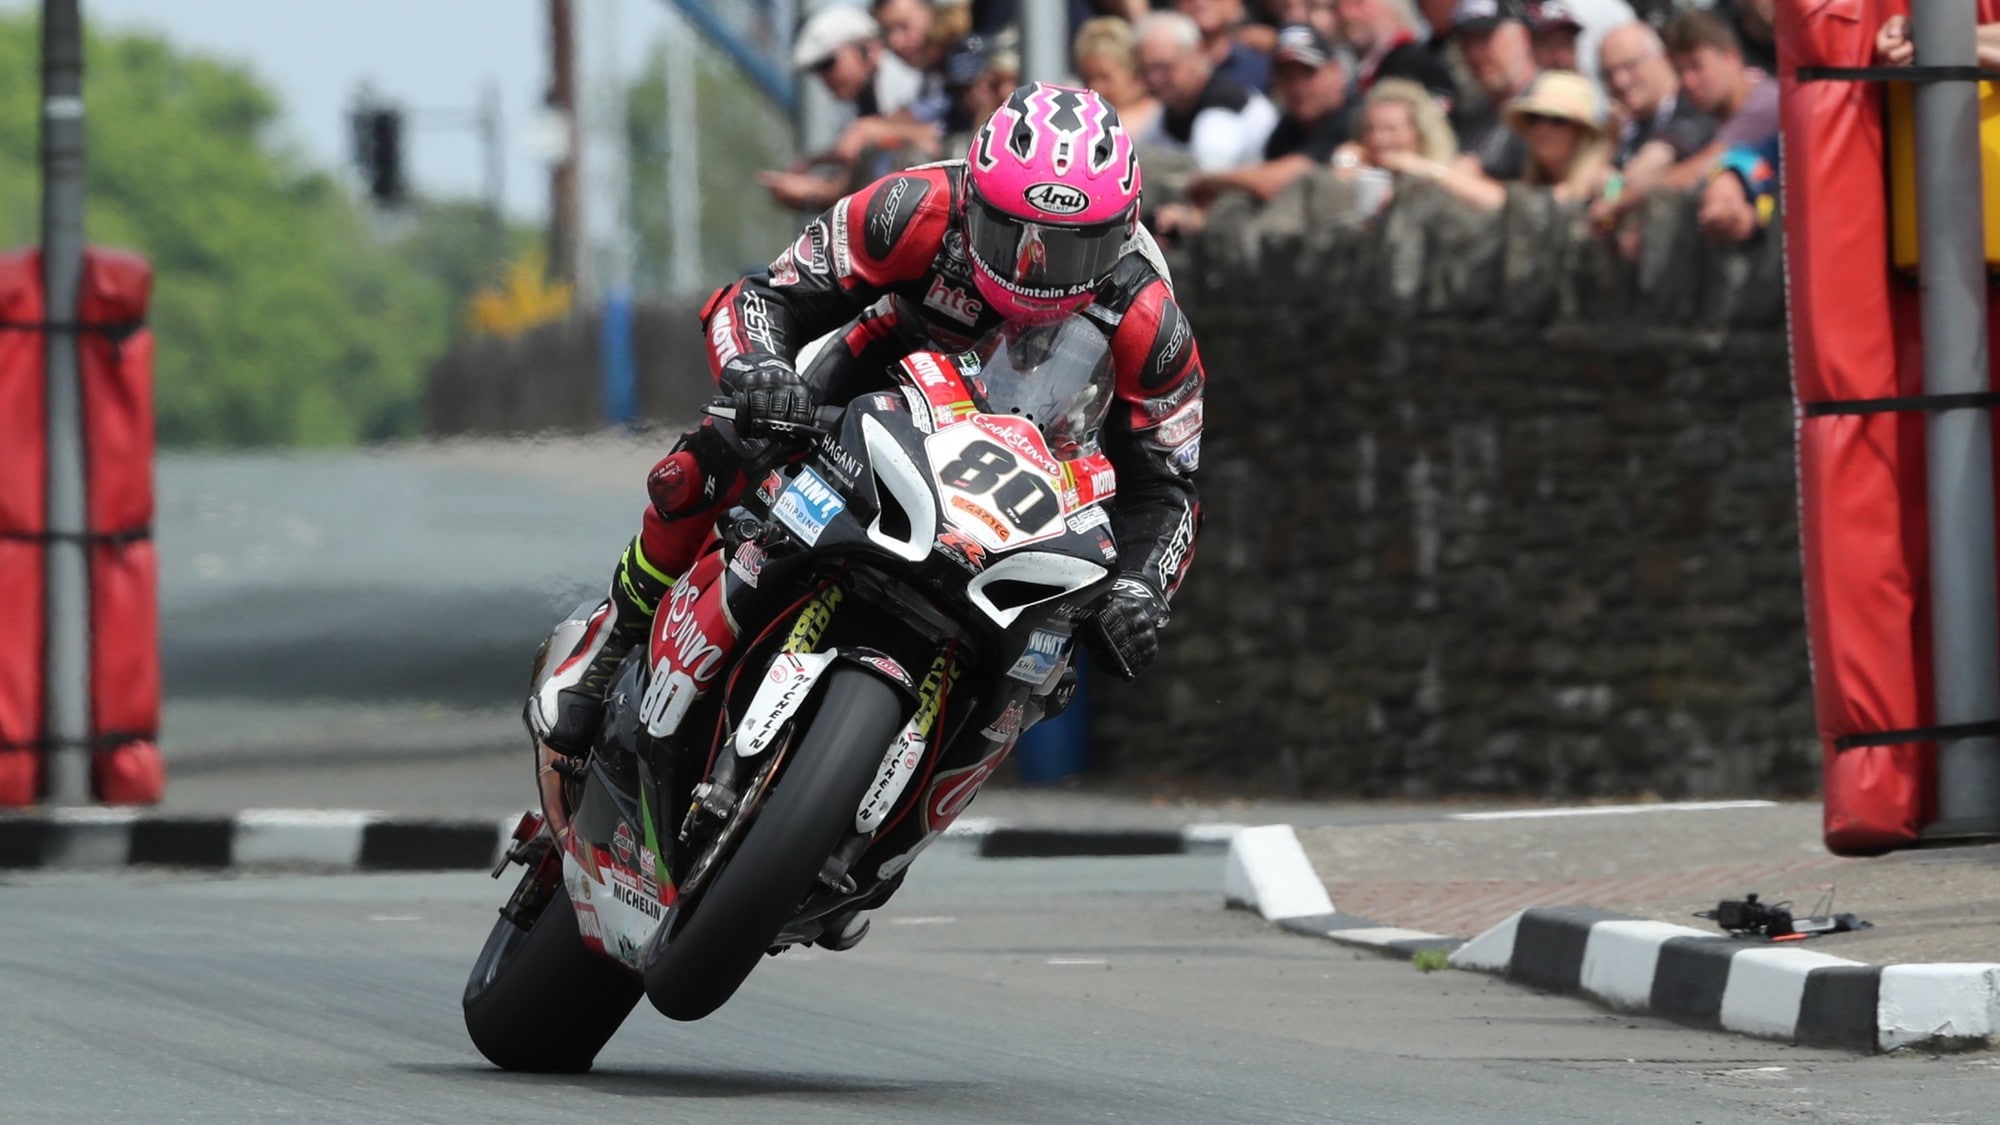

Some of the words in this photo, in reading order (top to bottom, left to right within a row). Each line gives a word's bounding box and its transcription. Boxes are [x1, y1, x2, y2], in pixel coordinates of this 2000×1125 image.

[880, 177, 908, 245] RST
[1028, 186, 1083, 208] Arai
[807, 224, 827, 272] HORAI
[928, 274, 982, 319] htc
[1068, 278, 1095, 296] 4x4
[743, 290, 777, 355] RST
[780, 496, 820, 535] SHIPPING
[939, 440, 1060, 536] 80
[639, 656, 698, 738] 80
[749, 673, 811, 749] MICHELIN
[859, 736, 910, 820] MICHELIN
[613, 882, 661, 921] MICHELIN
